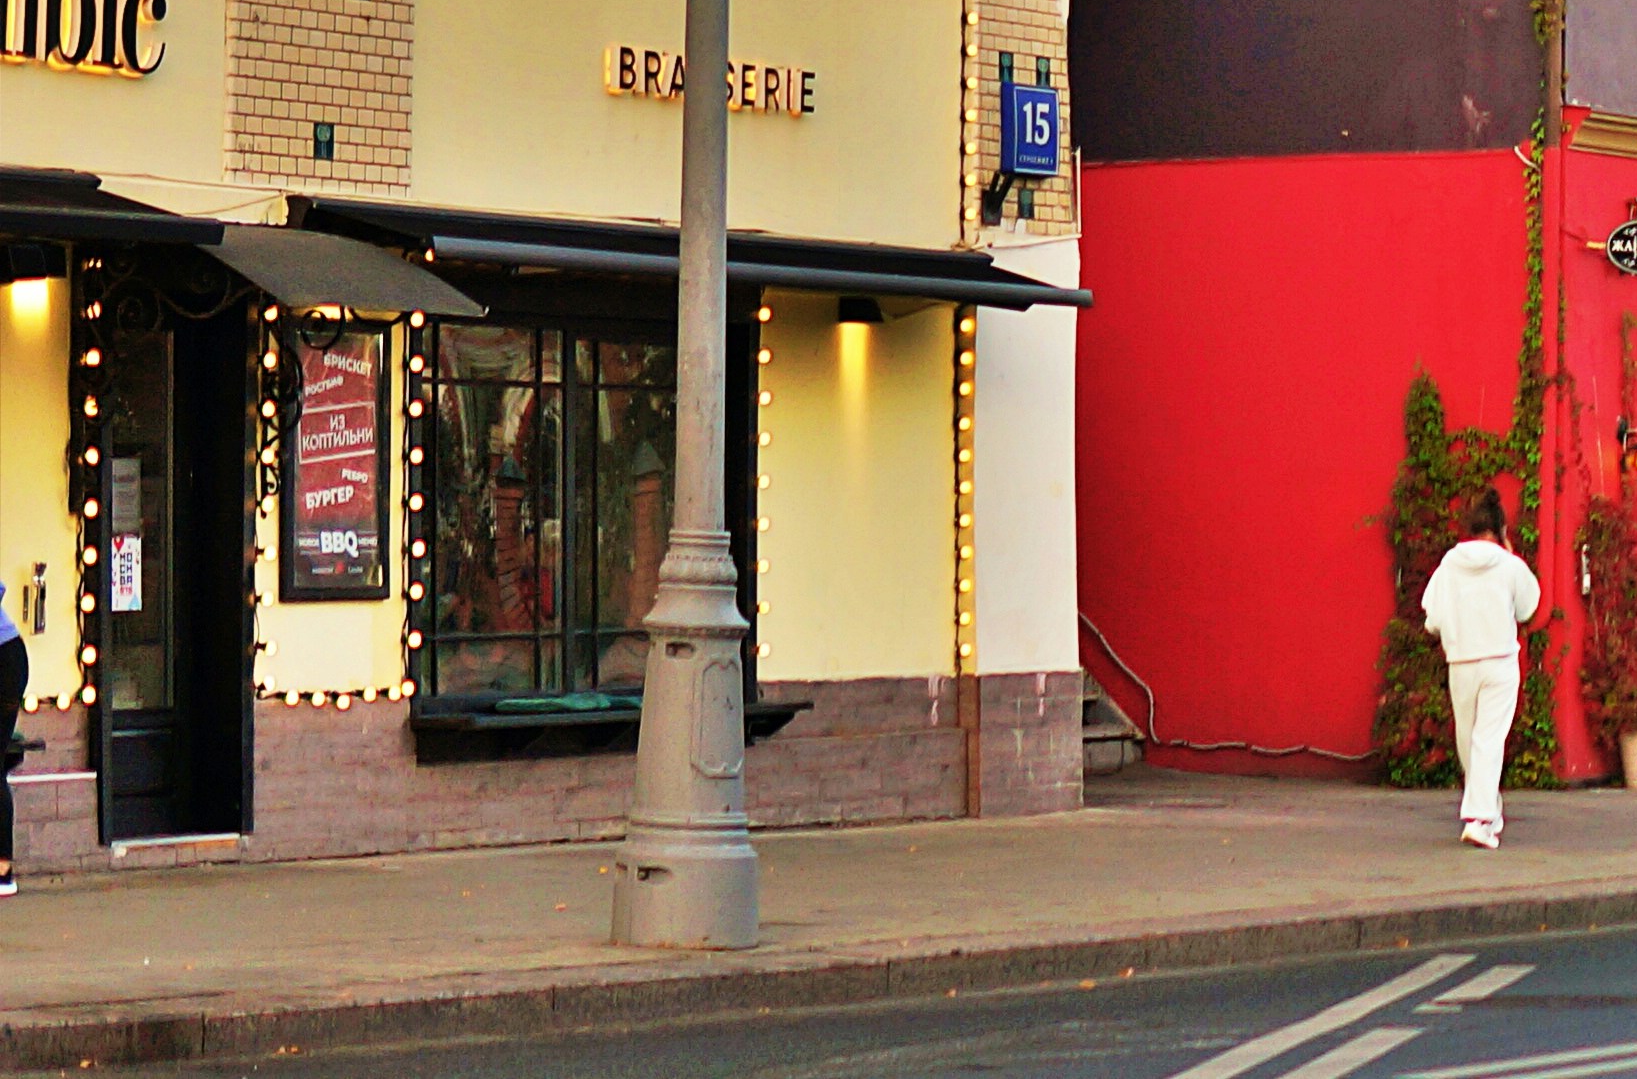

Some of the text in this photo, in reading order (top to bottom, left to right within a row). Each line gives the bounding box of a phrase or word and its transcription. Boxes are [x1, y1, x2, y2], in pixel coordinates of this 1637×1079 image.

[619, 46, 815, 113] BRAERIE
[1023, 101, 1050, 145] 15
[324, 353, 372, 377] БРИСКЕТ
[330, 414, 346, 431] ИЗ
[302, 428, 374, 451] КОПТИЛЬНИ
[305, 485, 354, 509] БУРГЕР
[320, 530, 359, 558] BBQ
